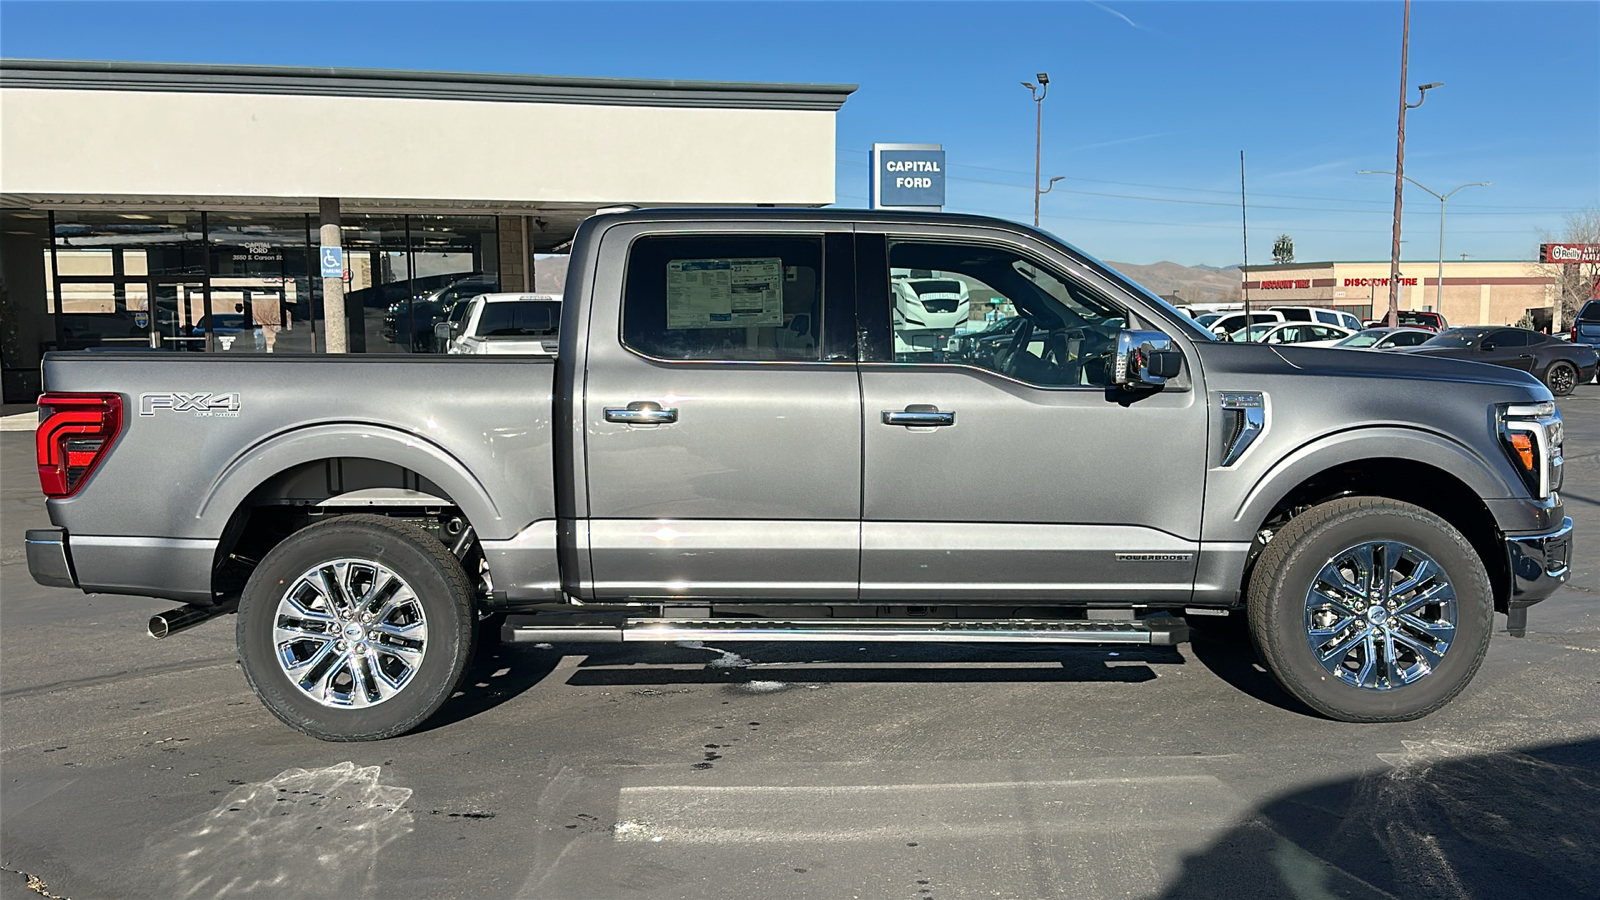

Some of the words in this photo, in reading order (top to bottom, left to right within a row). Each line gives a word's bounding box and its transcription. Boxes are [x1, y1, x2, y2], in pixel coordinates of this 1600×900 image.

[886, 161, 941, 172] CAPITAL
[896, 177, 932, 188] FORD
[1553, 246, 1581, 260] O'Reilly
[140, 392, 240, 417] FX4
